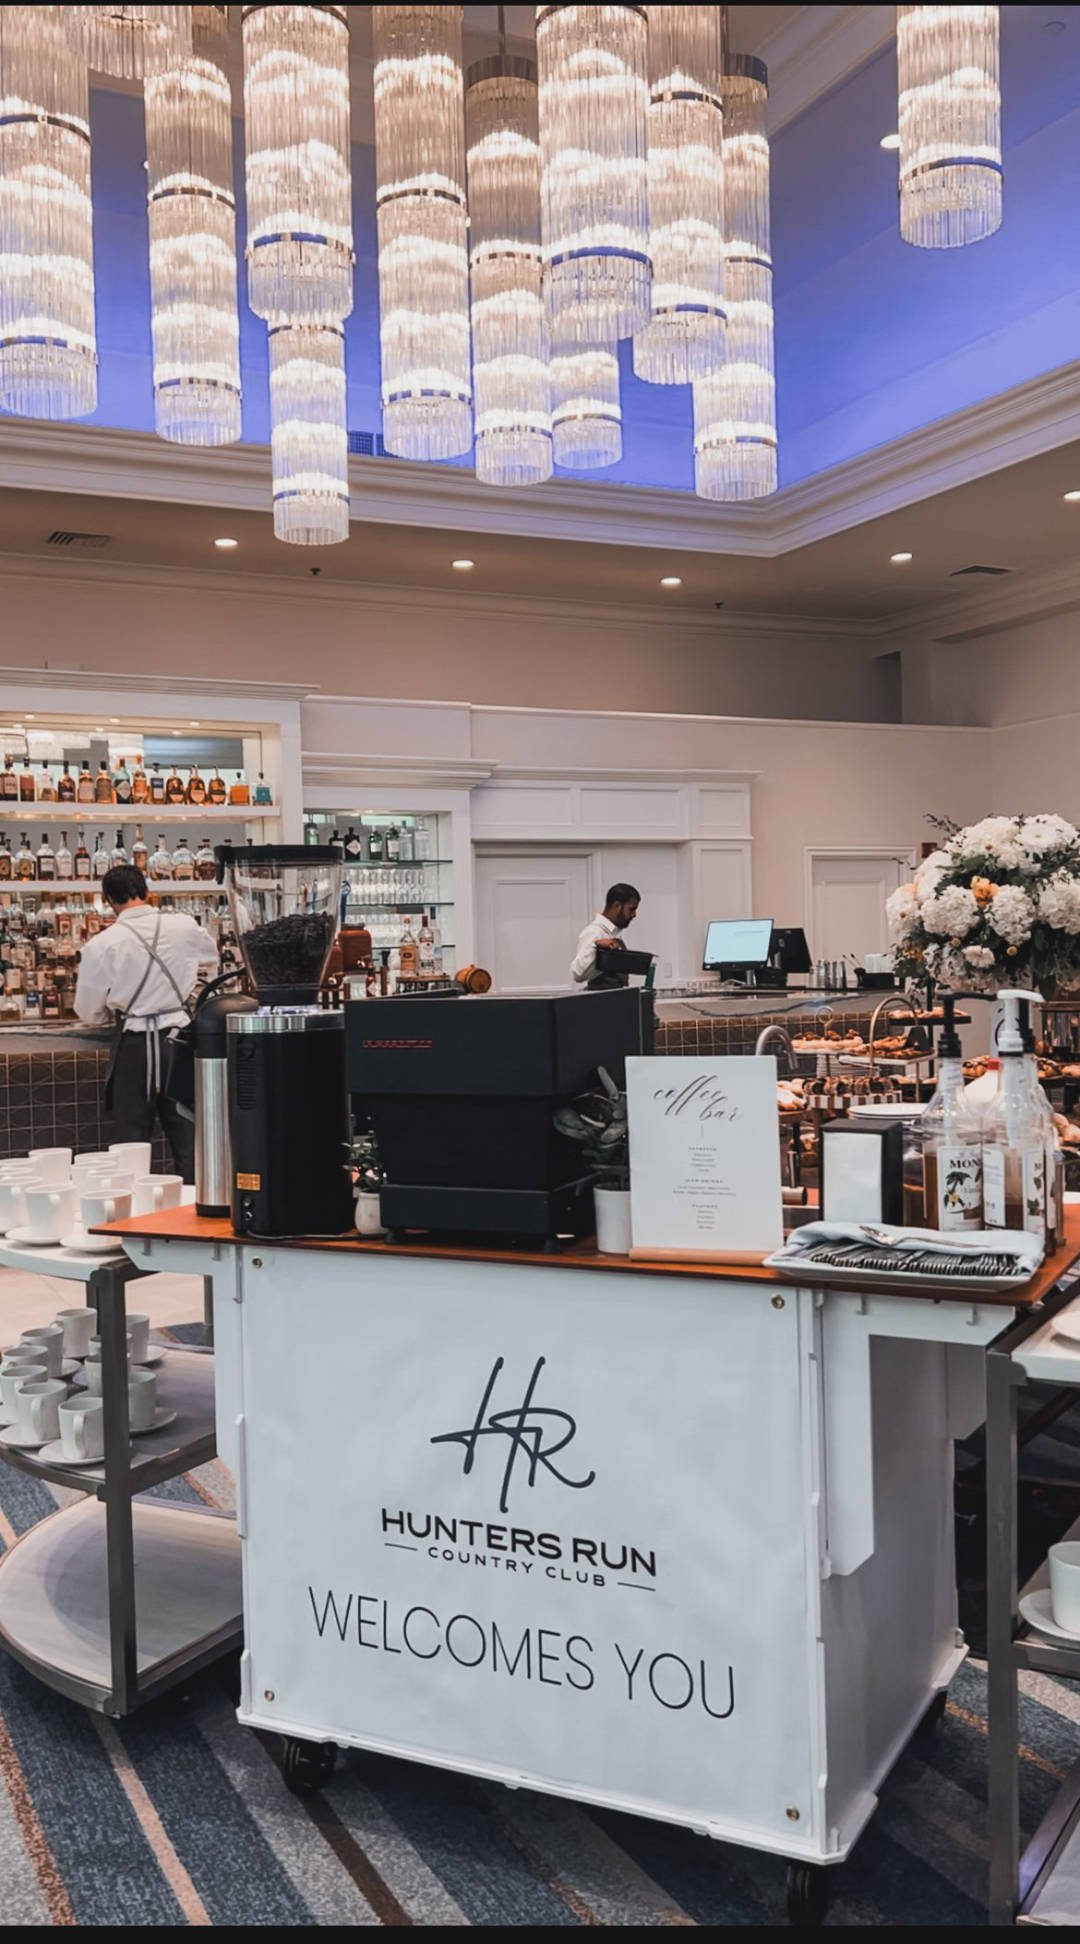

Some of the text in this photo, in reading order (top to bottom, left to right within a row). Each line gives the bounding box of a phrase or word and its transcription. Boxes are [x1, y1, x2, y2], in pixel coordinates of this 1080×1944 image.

[653, 1074, 722, 1116] coffee
[699, 1096, 739, 1122] bar
[381, 1508, 657, 1577] HUNTERS RUN
[428, 1546, 606, 1588] COUNTRY CLUB
[309, 1586, 735, 1719] WELCOMES YOU
